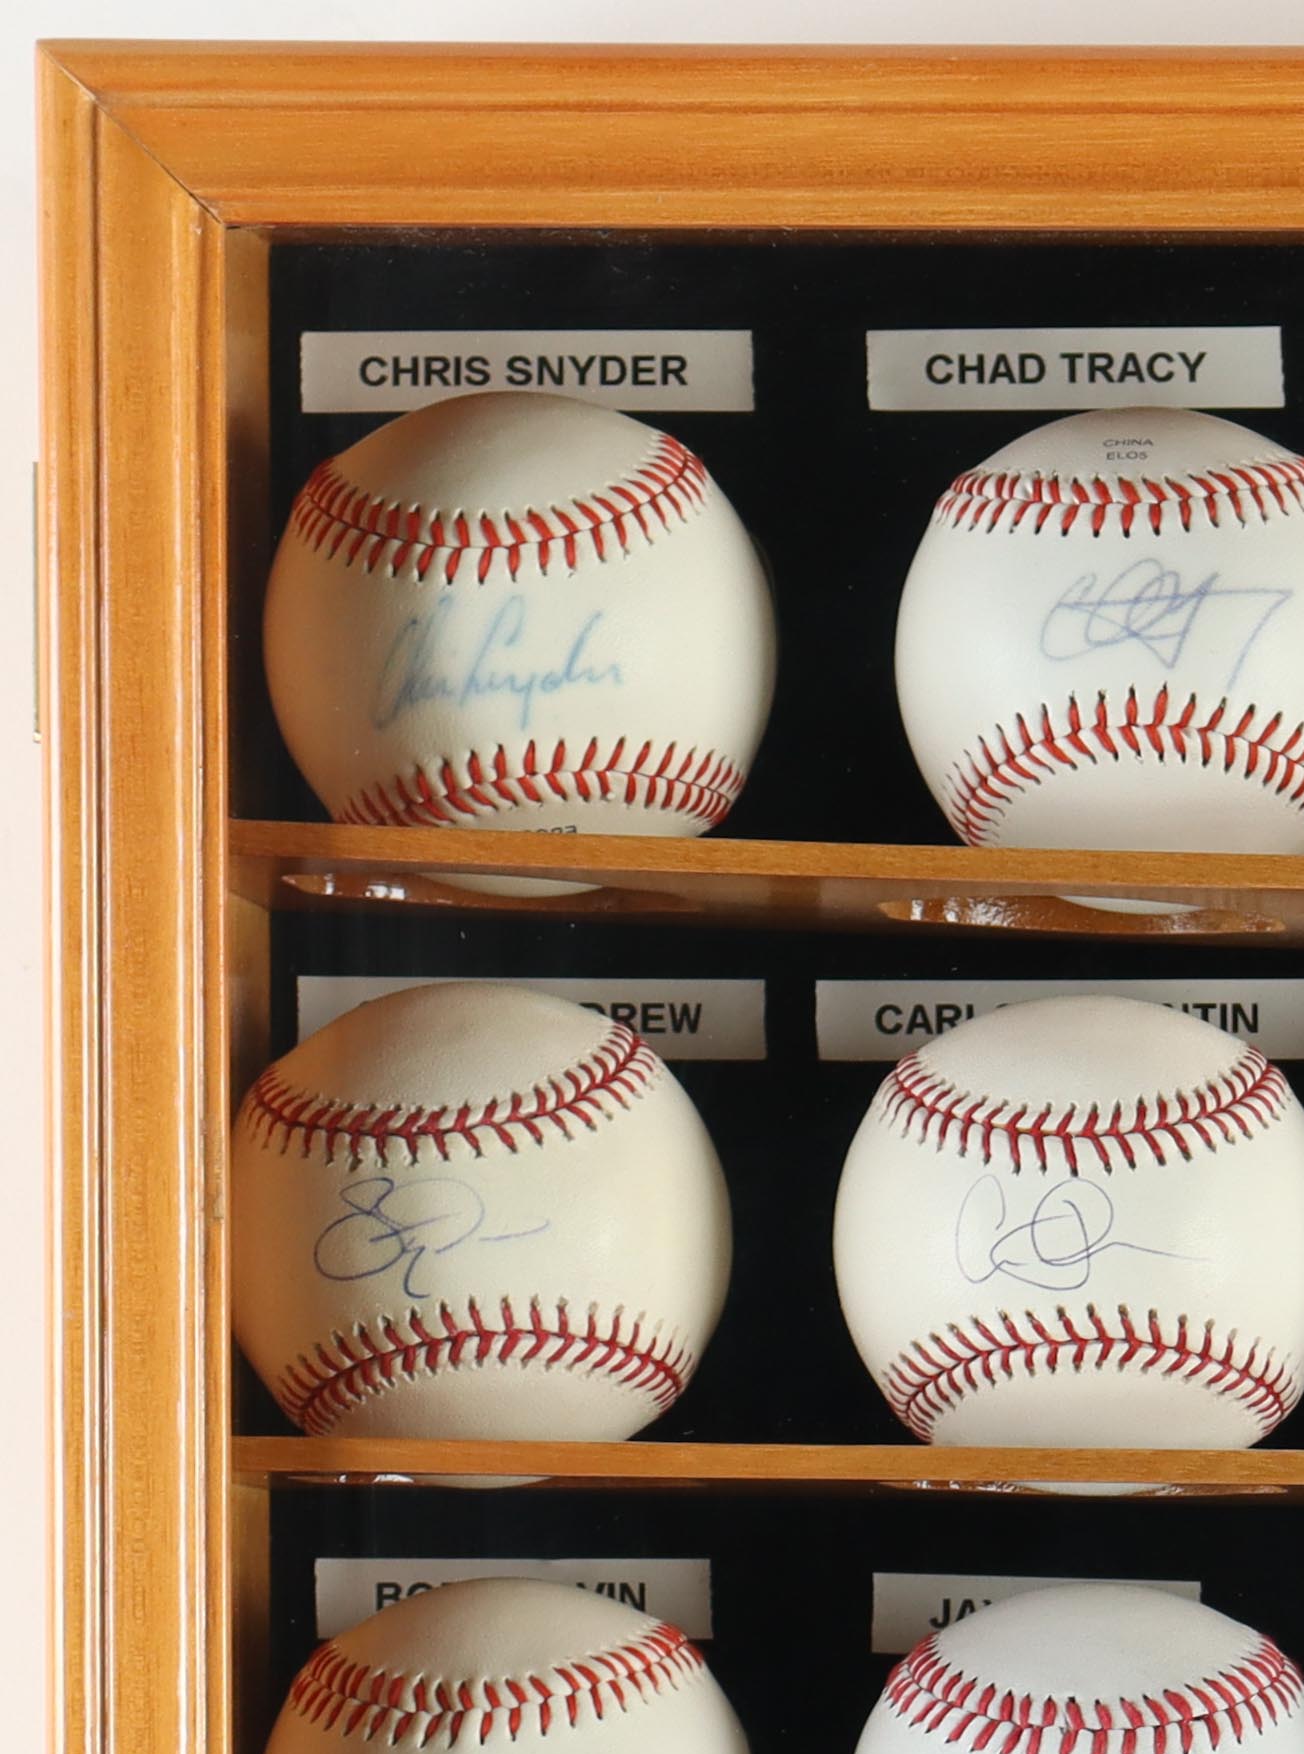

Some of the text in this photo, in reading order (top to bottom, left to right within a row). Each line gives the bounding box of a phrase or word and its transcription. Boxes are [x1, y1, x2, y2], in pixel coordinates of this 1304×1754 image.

[358, 354, 688, 388] CHRIS SNYDER
[925, 352, 1206, 385] CHAD TRACY
[1102, 438, 1154, 448] CHINA
